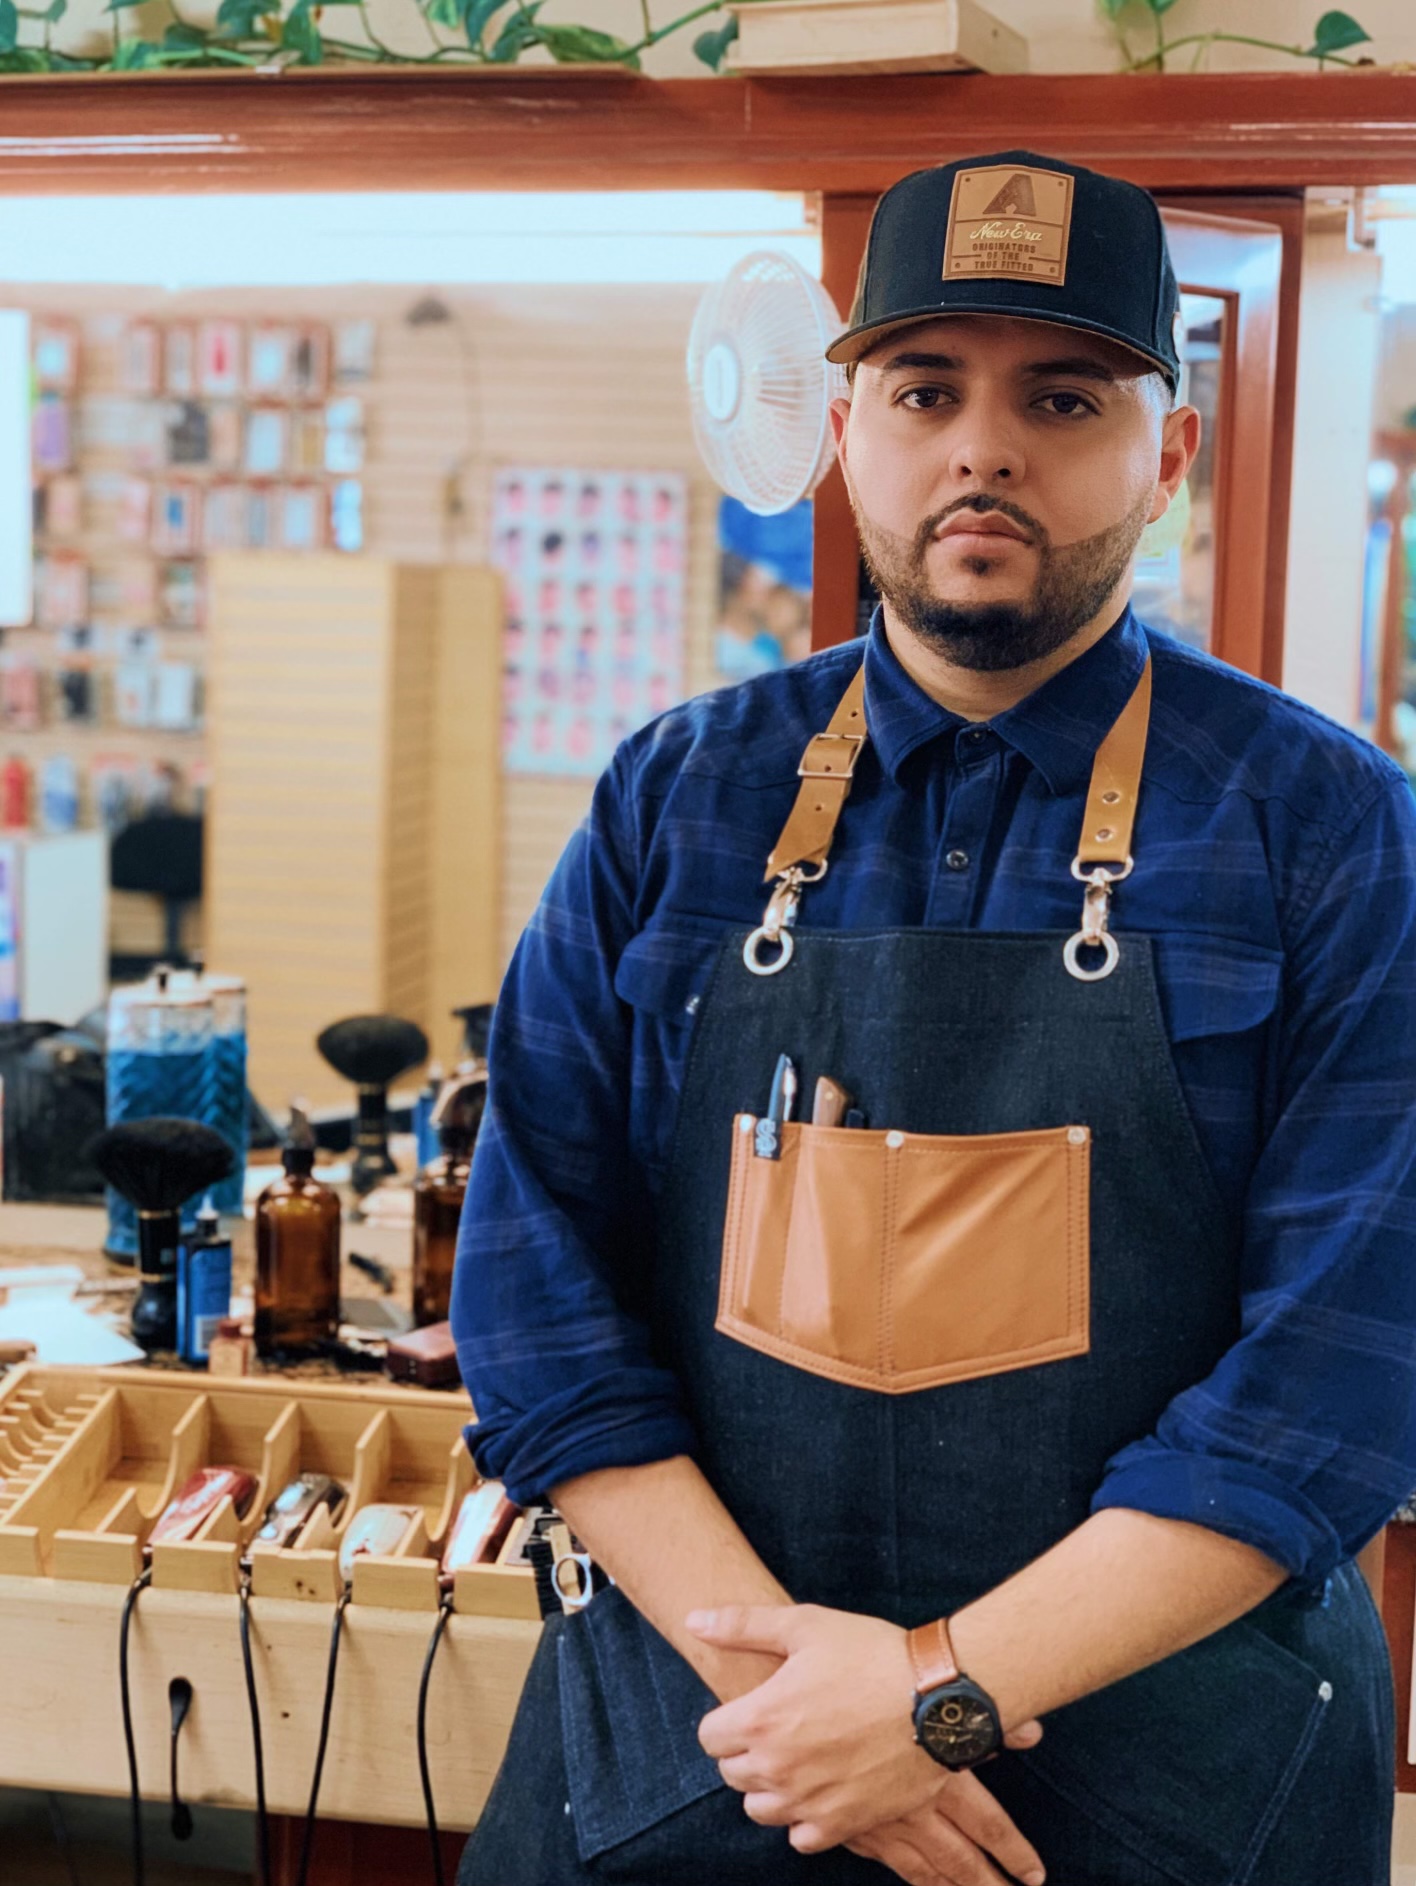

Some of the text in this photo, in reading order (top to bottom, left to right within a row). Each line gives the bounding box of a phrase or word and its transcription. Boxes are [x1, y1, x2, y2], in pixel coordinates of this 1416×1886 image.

[969, 221, 1043, 241] New Era
[972, 242, 1036, 254] ORIGINATORS
[986, 251, 1020, 260] OF THE
[974, 260, 1034, 272] TRUE FITTED
